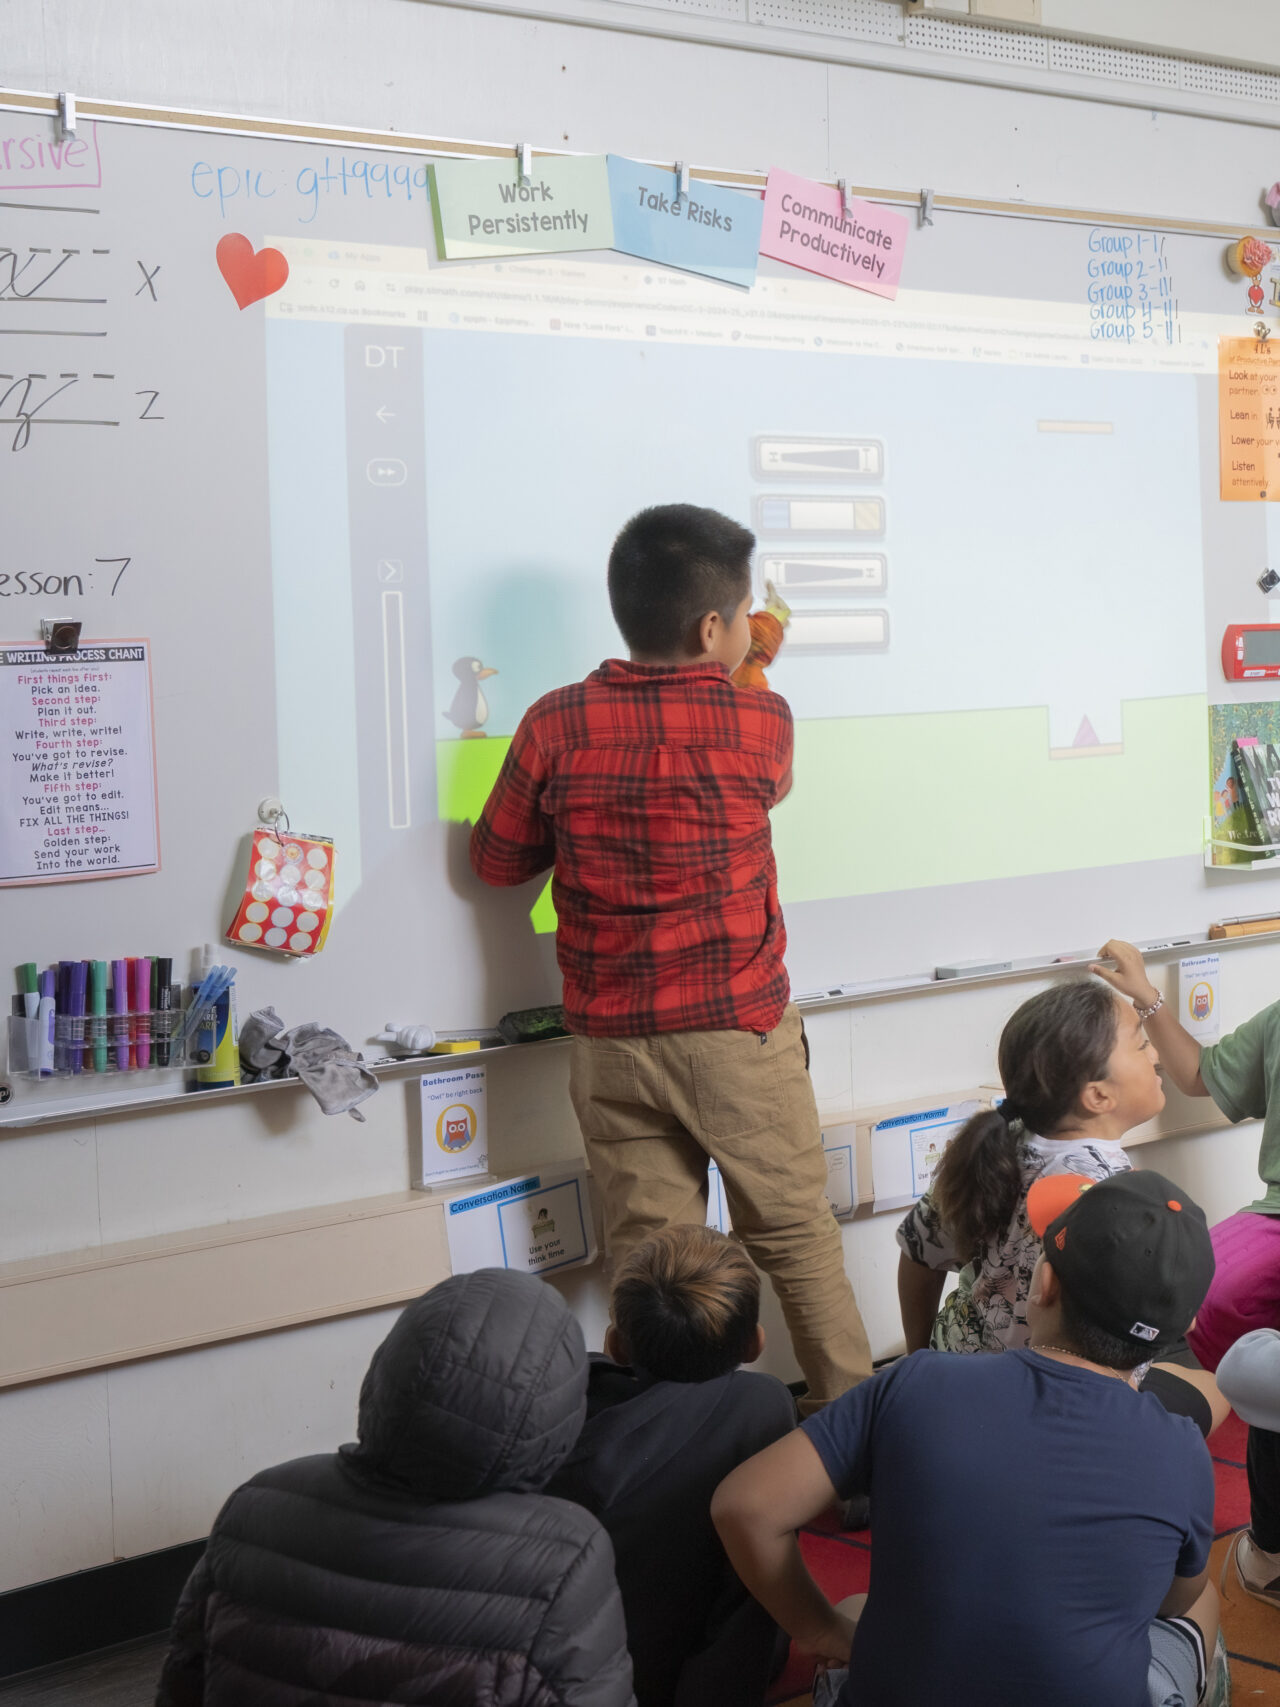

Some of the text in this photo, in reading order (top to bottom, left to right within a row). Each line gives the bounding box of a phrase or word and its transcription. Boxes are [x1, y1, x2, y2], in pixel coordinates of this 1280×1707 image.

[498, 181, 554, 204] Work
[637, 185, 734, 233] Take Risks
[468, 208, 589, 236] Persistently
[780, 193, 893, 252] Communicate
[778, 219, 887, 280] Productively
[1088, 228, 1133, 258] Group
[1087, 258, 1133, 284] Group
[1087, 281, 1133, 304] Group
[1089, 302, 1136, 324] Group
[1090, 320, 1136, 345] Group
[364, 344, 404, 368] DT
[1229, 369, 1248, 380] Look
[1259, 374, 1278, 384] your
[1230, 409, 1249, 420] Lean
[1231, 435, 1255, 446] Lower
[1256, 438, 1274, 448] your
[1232, 460, 1255, 471] Listen
[108, 647, 144, 660] CHANT
[17, 674, 44, 685] First
[47, 673, 80, 684] things
[31, 684, 101, 695] Pick an idea.
[31, 694, 101, 706] Second step:
[37, 705, 97, 717] Plan it out.
[39, 717, 97, 728] Third step:
[15, 725, 122, 740] Write, write, write!
[35, 738, 103, 750] Fourth step:
[12, 747, 128, 762] You've got to revise.
[31, 757, 114, 772] What's revise?
[29, 768, 115, 783] Make it better!
[44, 781, 102, 793] Fifth step:
[22, 789, 124, 806] You've got to edit.
[40, 804, 61, 816] Edit
[19, 810, 130, 828] FIX ALL THE THINGS!
[47, 826, 71, 837] Last
[43, 835, 111, 848] Golden step:
[34, 843, 121, 860] Send your work
[36, 854, 120, 870] Into the world.
[422, 1071, 485, 1087] Bathroom Pass
[454, 1090, 468, 1098] right
[469, 1087, 483, 1095] back
[877, 1114, 922, 1129] Conversation
[450, 1179, 538, 1213] Conversation Norms
[529, 1239, 561, 1255] Use your
[527, 1248, 565, 1266] think time
